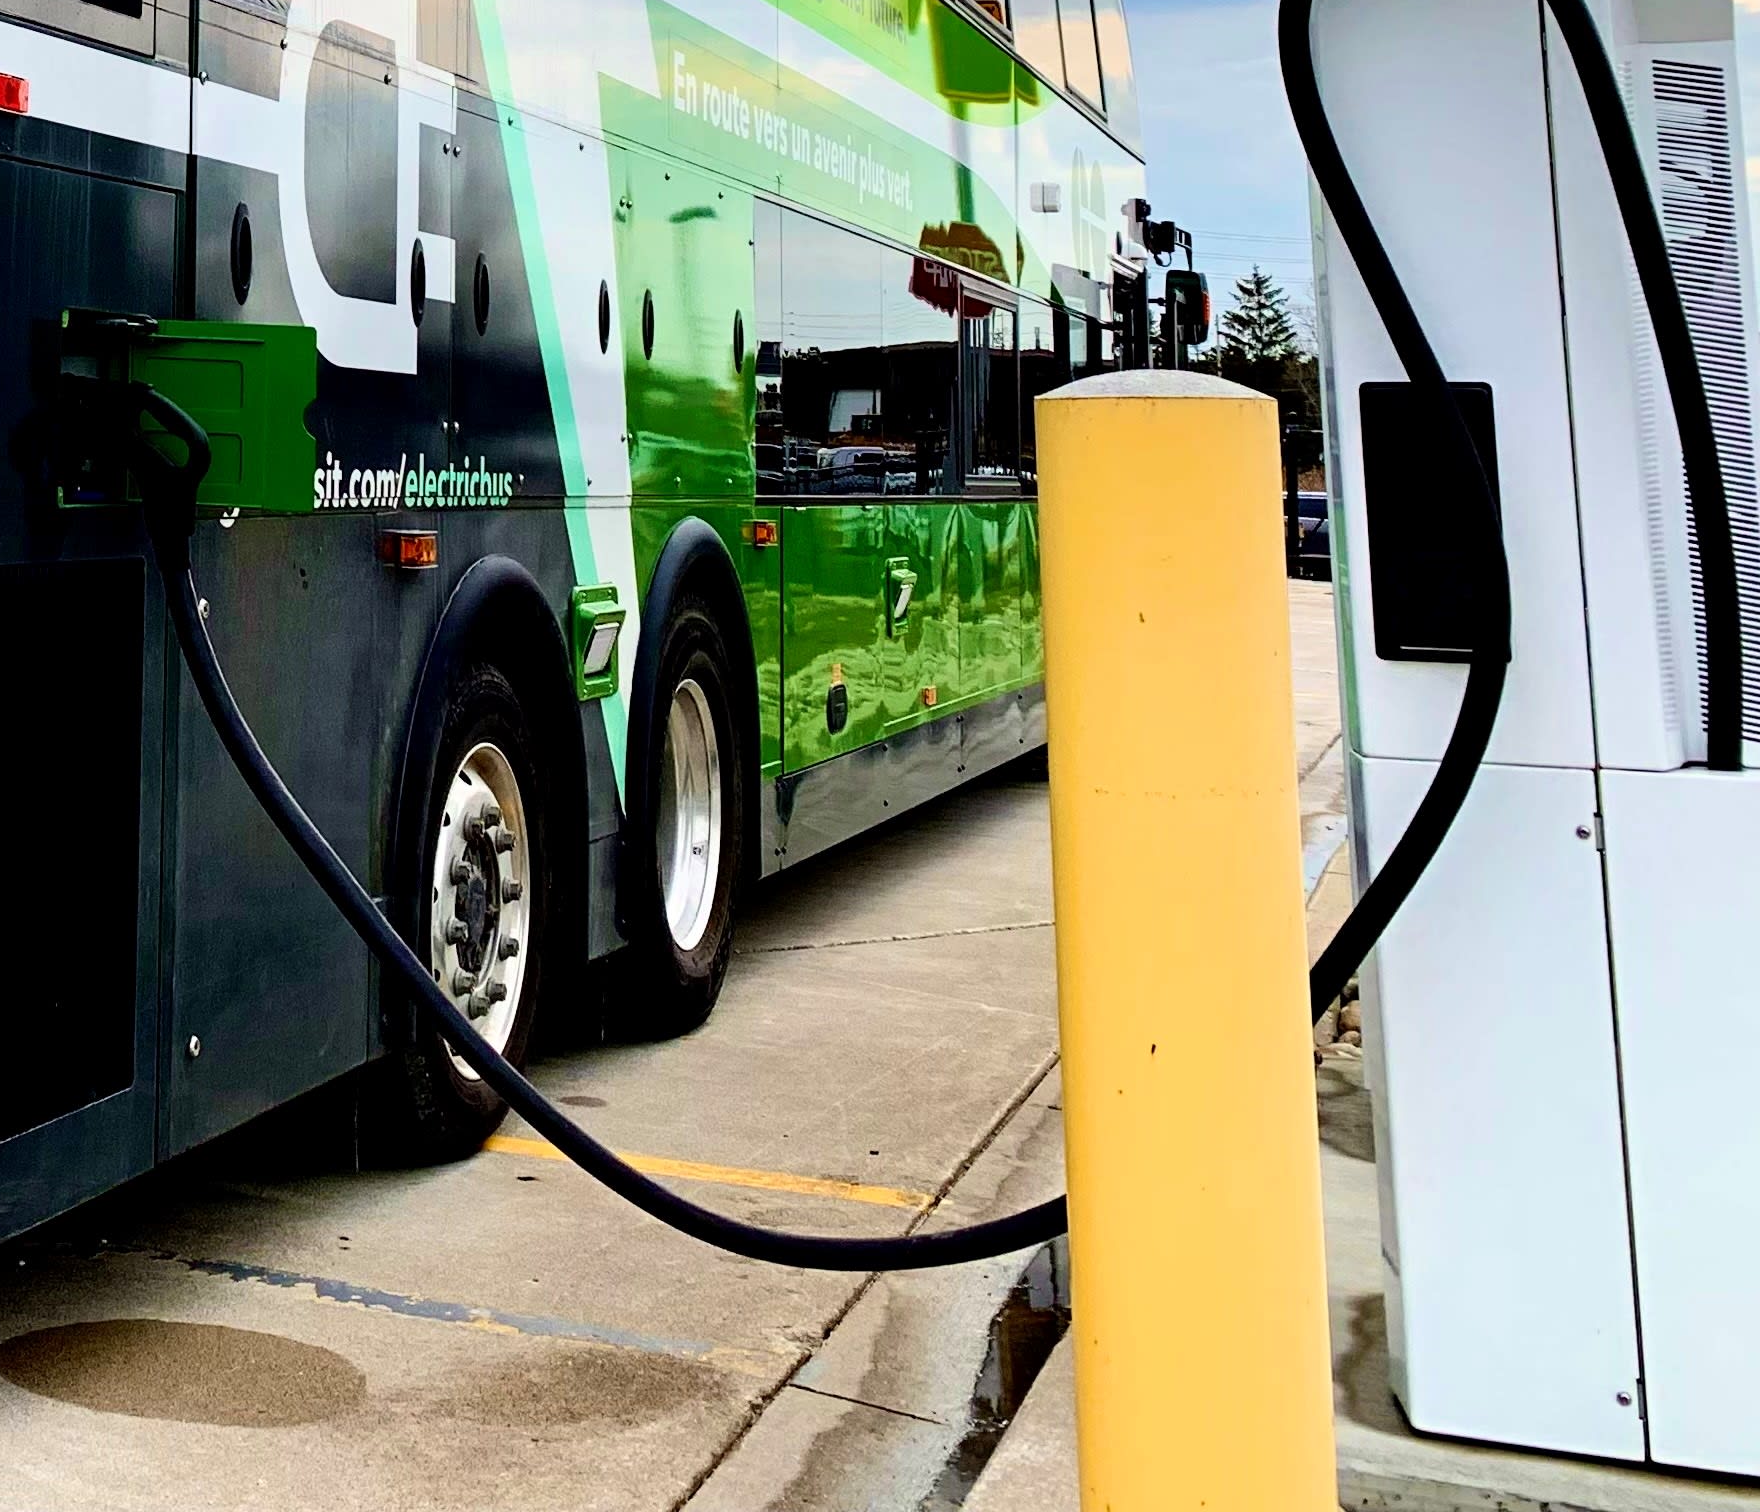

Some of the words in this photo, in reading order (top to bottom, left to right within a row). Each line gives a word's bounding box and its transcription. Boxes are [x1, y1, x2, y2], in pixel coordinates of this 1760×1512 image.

[673, 48, 697, 117] En
[703, 81, 750, 139] route
[753, 104, 788, 156] vers
[791, 122, 811, 166] un
[814, 132, 857, 186] avenir
[859, 143, 886, 205] plus
[886, 166, 913, 212] vert.
[313, 450, 513, 510] sit.com/electricbus
